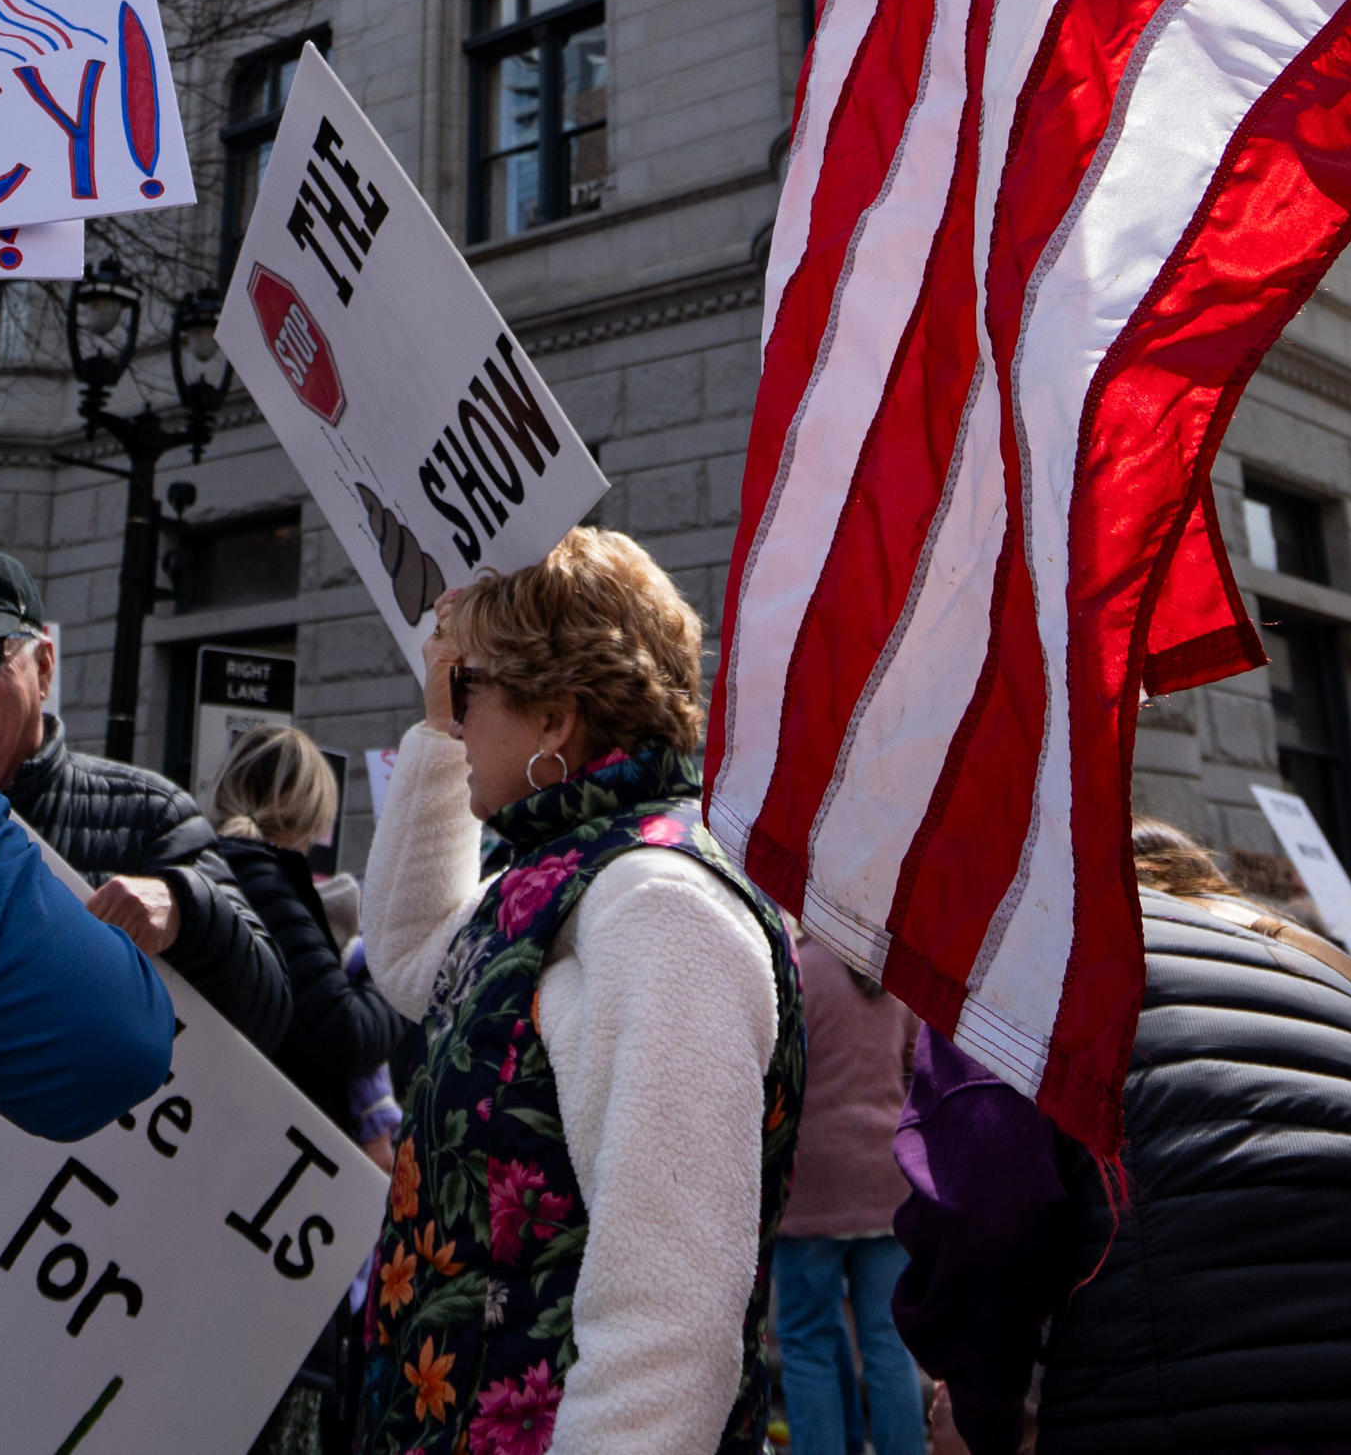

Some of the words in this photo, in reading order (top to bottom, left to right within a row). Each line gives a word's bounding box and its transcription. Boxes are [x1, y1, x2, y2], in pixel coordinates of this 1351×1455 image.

[286, 115, 390, 308] THE
[275, 303, 318, 387] STOP
[418, 332, 562, 570] SHOW
[225, 660, 272, 682] RIGHT
[226, 683, 269, 704] LANE
[225, 1125, 340, 1281] Is
